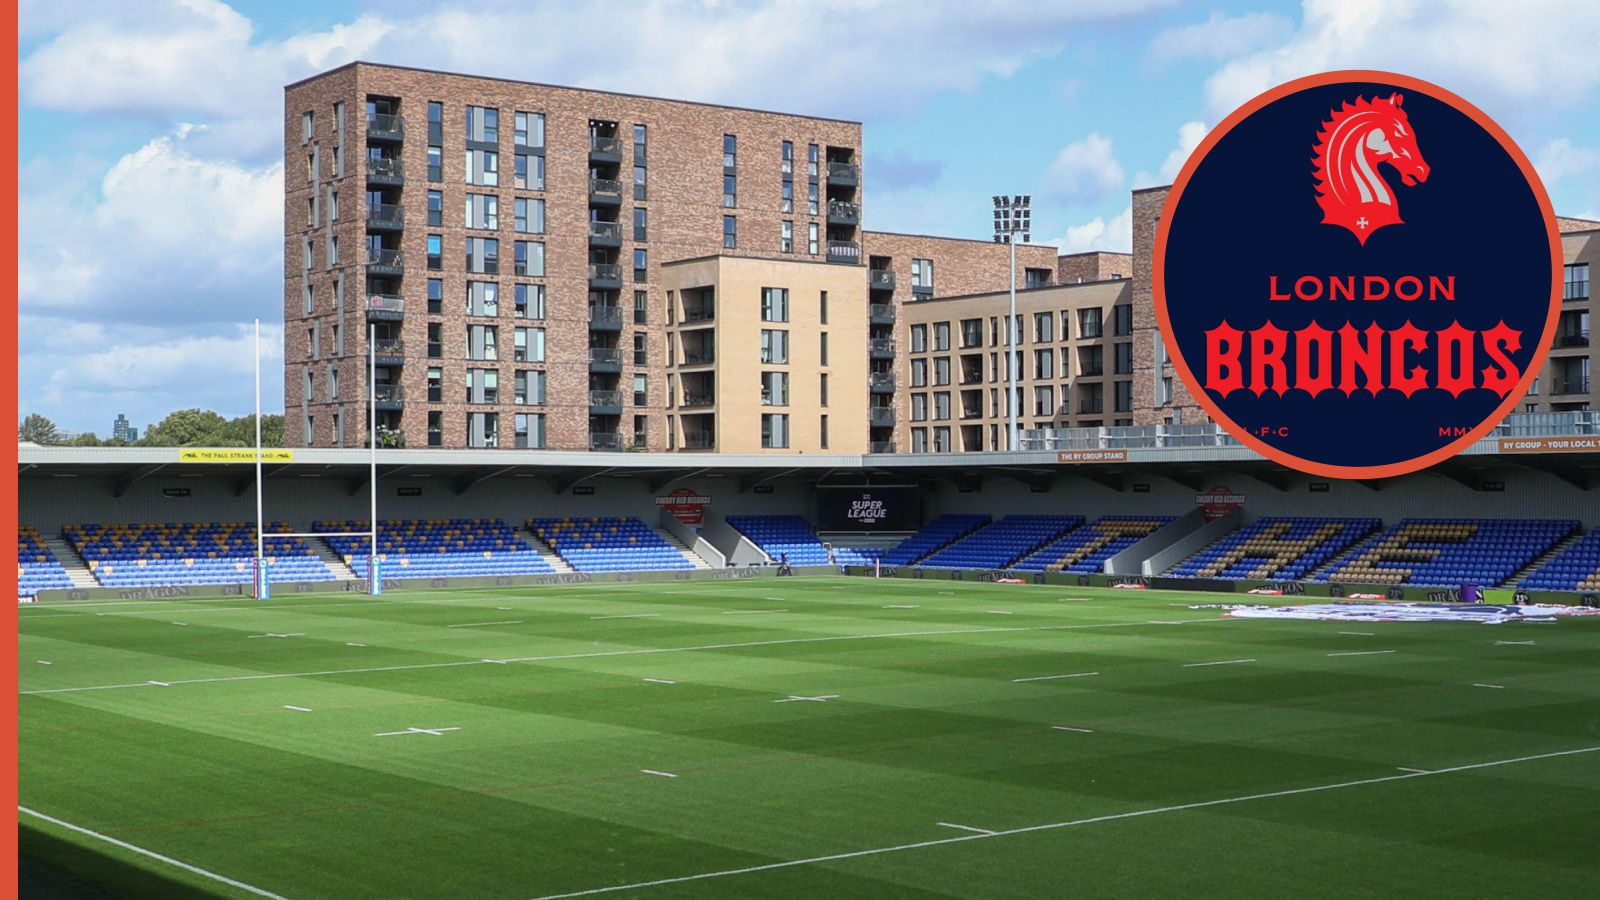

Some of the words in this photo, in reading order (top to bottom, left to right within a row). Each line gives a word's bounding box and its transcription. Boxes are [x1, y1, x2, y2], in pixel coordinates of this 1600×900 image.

[1515, 441, 1542, 449] GROUP
[1570, 440, 1596, 448] LOCAL
[852, 501, 882, 509] SUPER
[847, 509, 887, 518] LEAGUE
